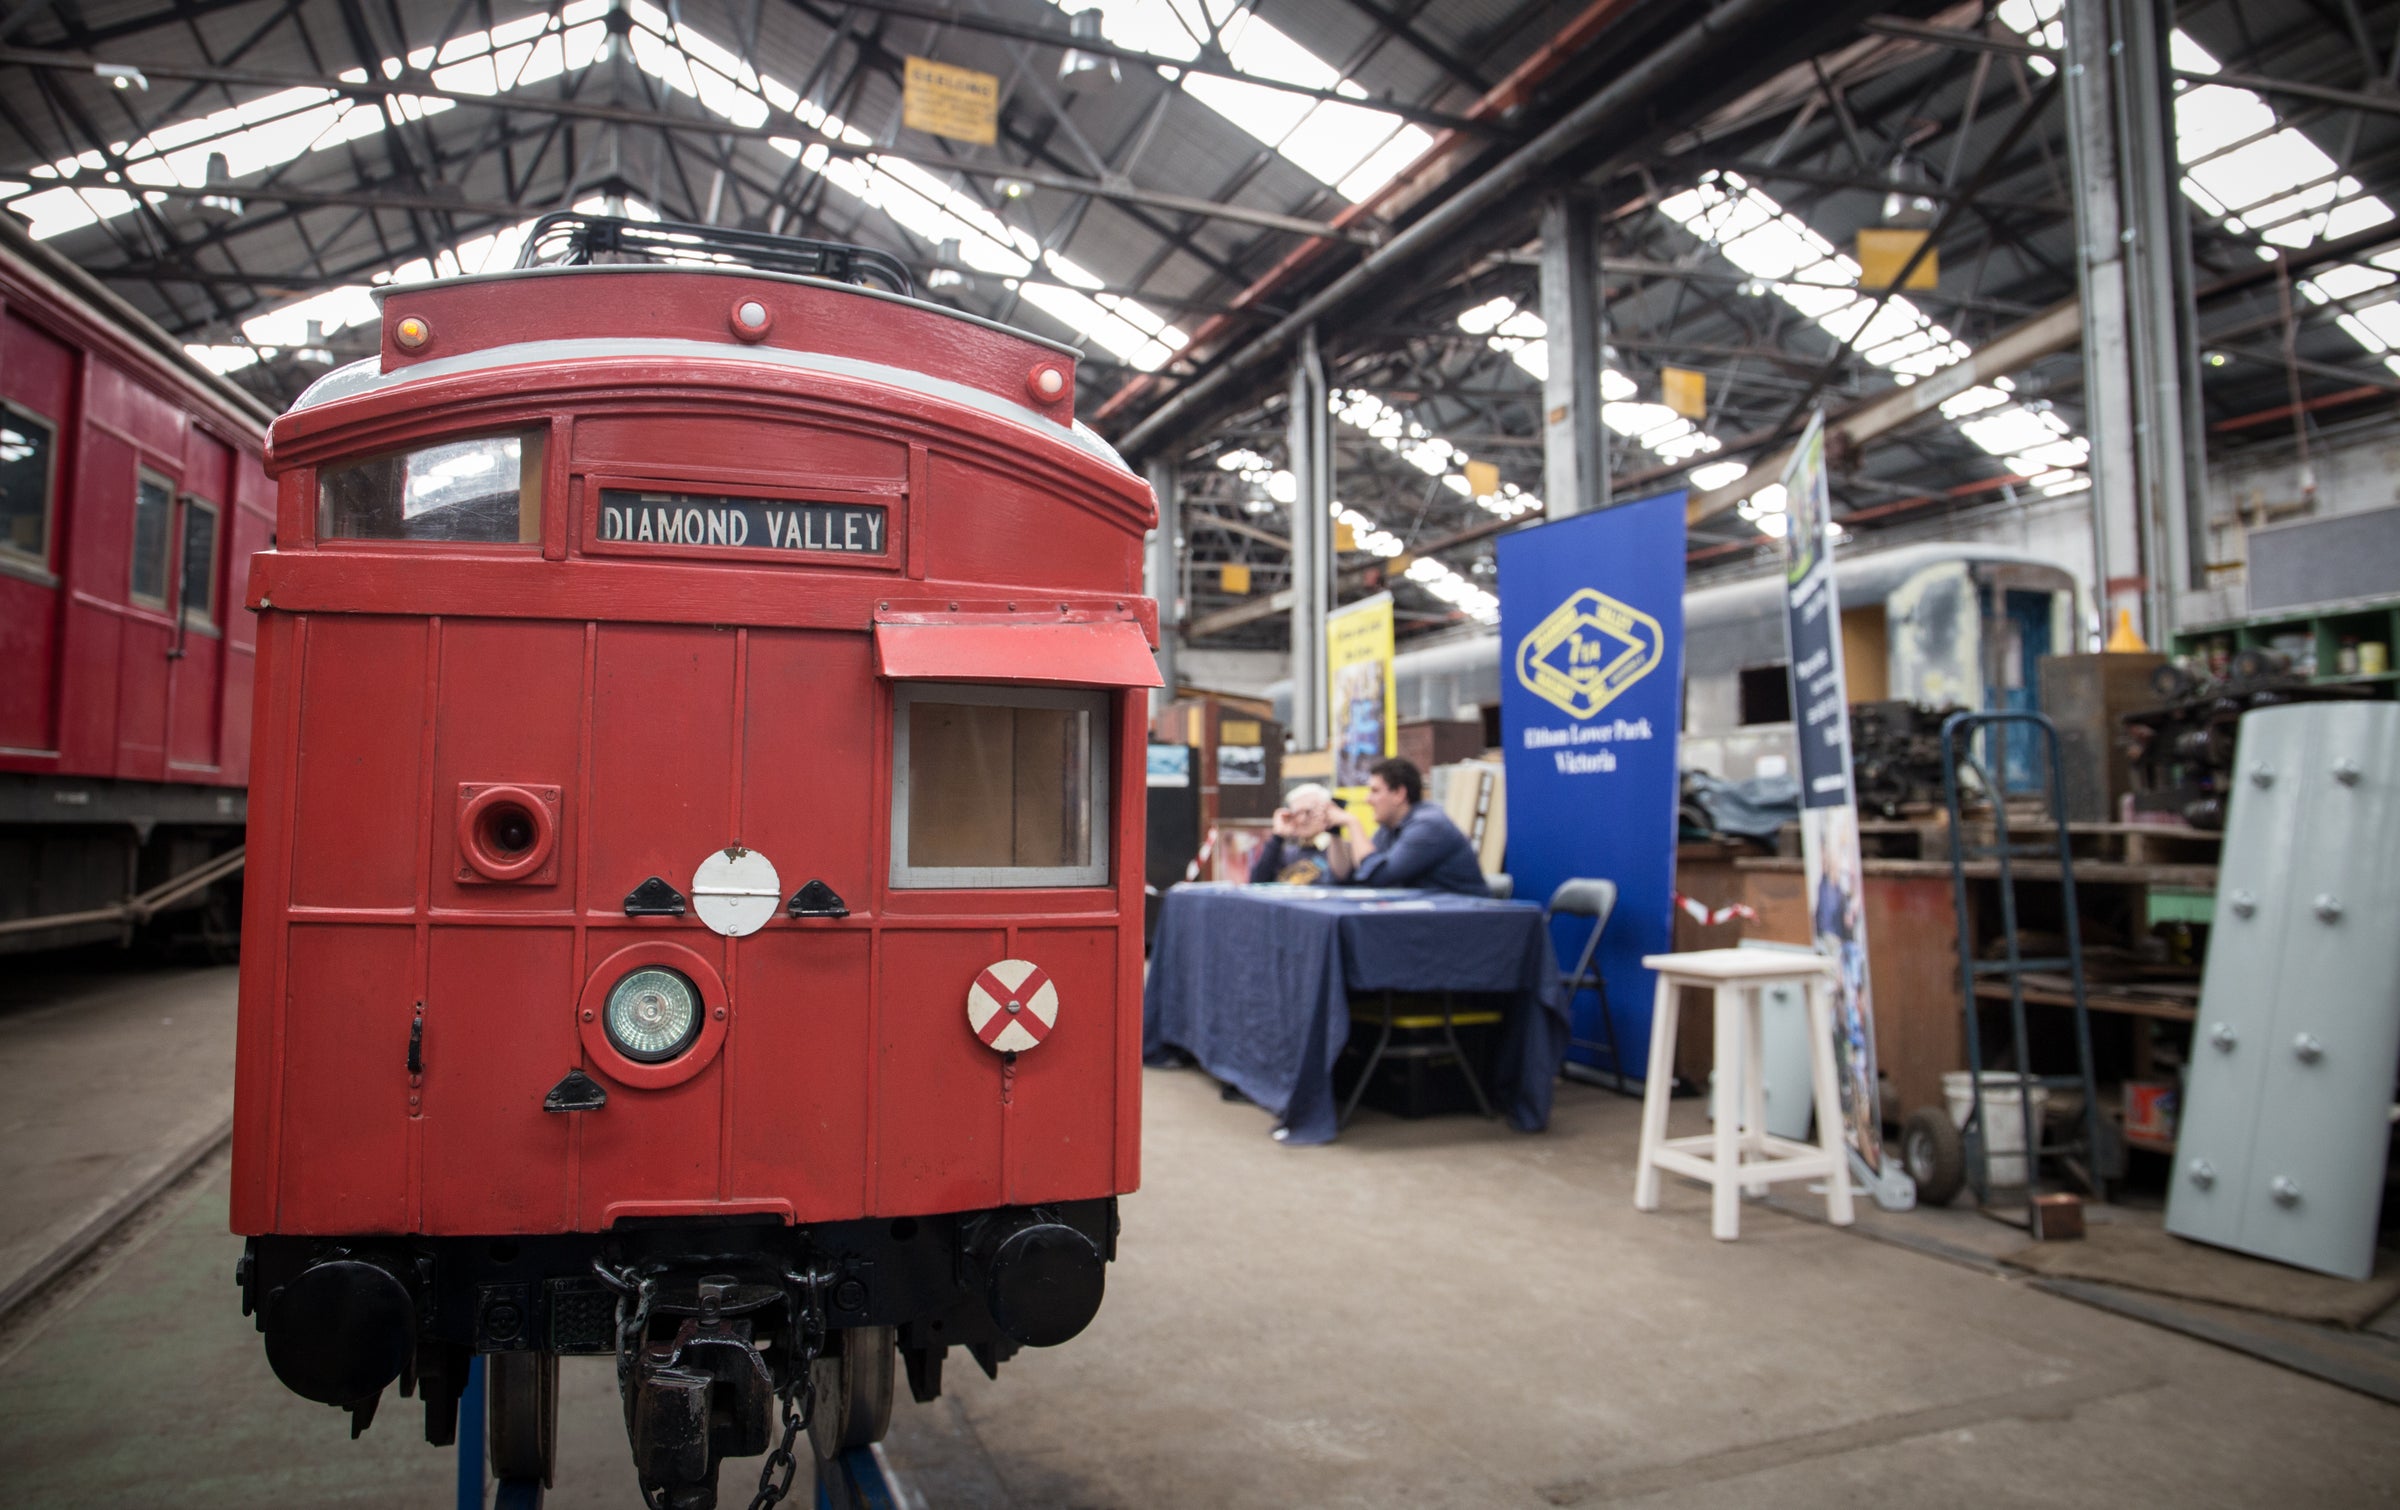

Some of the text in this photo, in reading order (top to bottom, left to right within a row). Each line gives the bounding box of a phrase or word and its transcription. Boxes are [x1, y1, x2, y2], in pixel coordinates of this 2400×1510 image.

[604, 507, 882, 550] DIAMOND VALLEY
[1569, 723, 1613, 745] Lower
[1613, 717, 1652, 741] Park
[1554, 748, 1617, 774] Victoria
